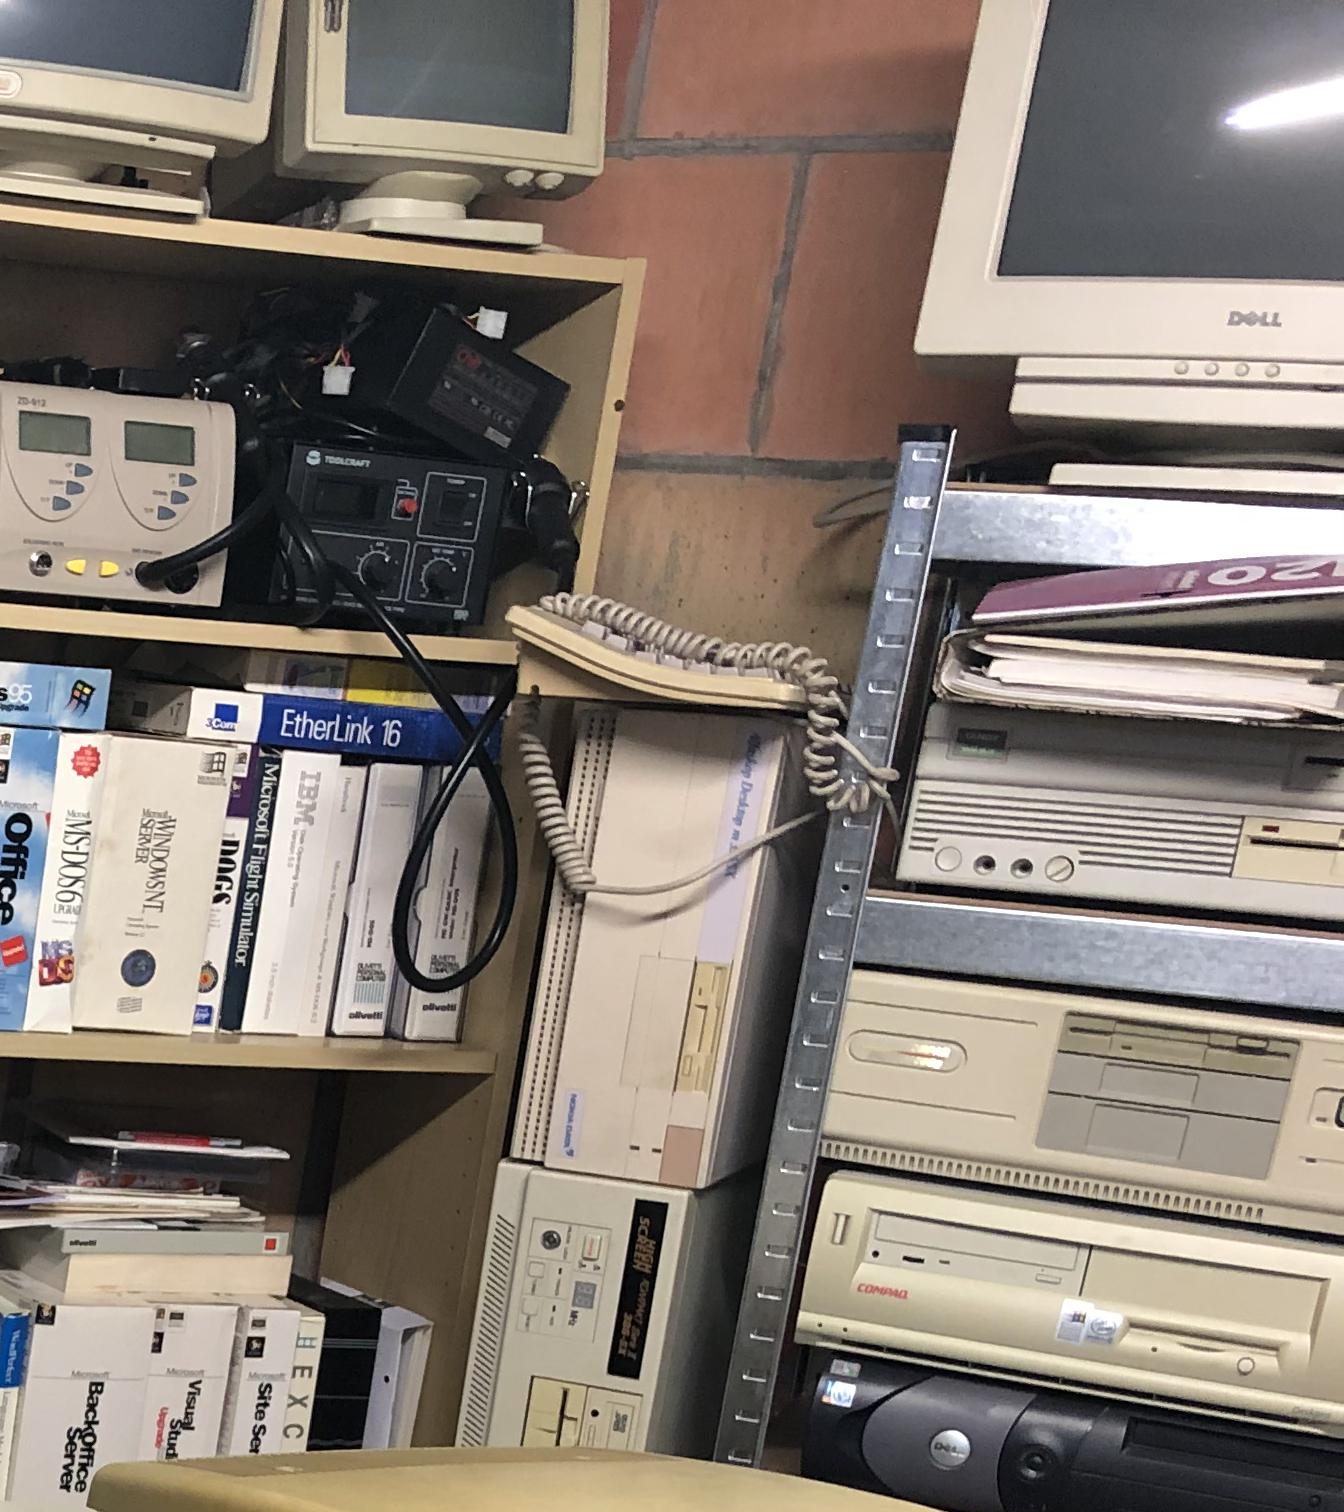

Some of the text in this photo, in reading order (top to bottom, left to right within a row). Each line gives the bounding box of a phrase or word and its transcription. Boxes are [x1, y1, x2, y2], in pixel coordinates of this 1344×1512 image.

[1227, 310, 1283, 328] DELL
[324, 455, 371, 469] TOOLCRAFT
[205, 717, 239, 731] 3Com
[281, 708, 402, 748] EtherLink 16
[293, 770, 322, 826] IBM
[57, 818, 93, 888] MS-DOS
[134, 818, 155, 864] SERVER
[146, 816, 177, 889] WINDOWS
[213, 838, 240, 905] DOGS
[234, 763, 280, 967] Microsoft Flight Simulator
[142, 890, 166, 913] NT
[355, 974, 387, 982] COMPUTER
[348, 1010, 383, 1020] olivetti
[422, 1002, 457, 1012] olivetti
[69, 1239, 97, 1247] olivetti
[633, 1215, 650, 1273] SCREEN
[642, 1239, 657, 1274] HIGH
[856, 1282, 909, 1300] COMPAQ
[568, 1310, 579, 1327] MHz
[4, 1329, 21, 1384] WordPerfect
[71, 1370, 111, 1380] Microsoft
[167, 1367, 205, 1377] Microsoft
[181, 1379, 203, 1431] Visual
[249, 1382, 273, 1454] Site Ser
[74, 1381, 105, 1493] BackOffice
[165, 1418, 183, 1460] Stud
[59, 1426, 83, 1493] Server
